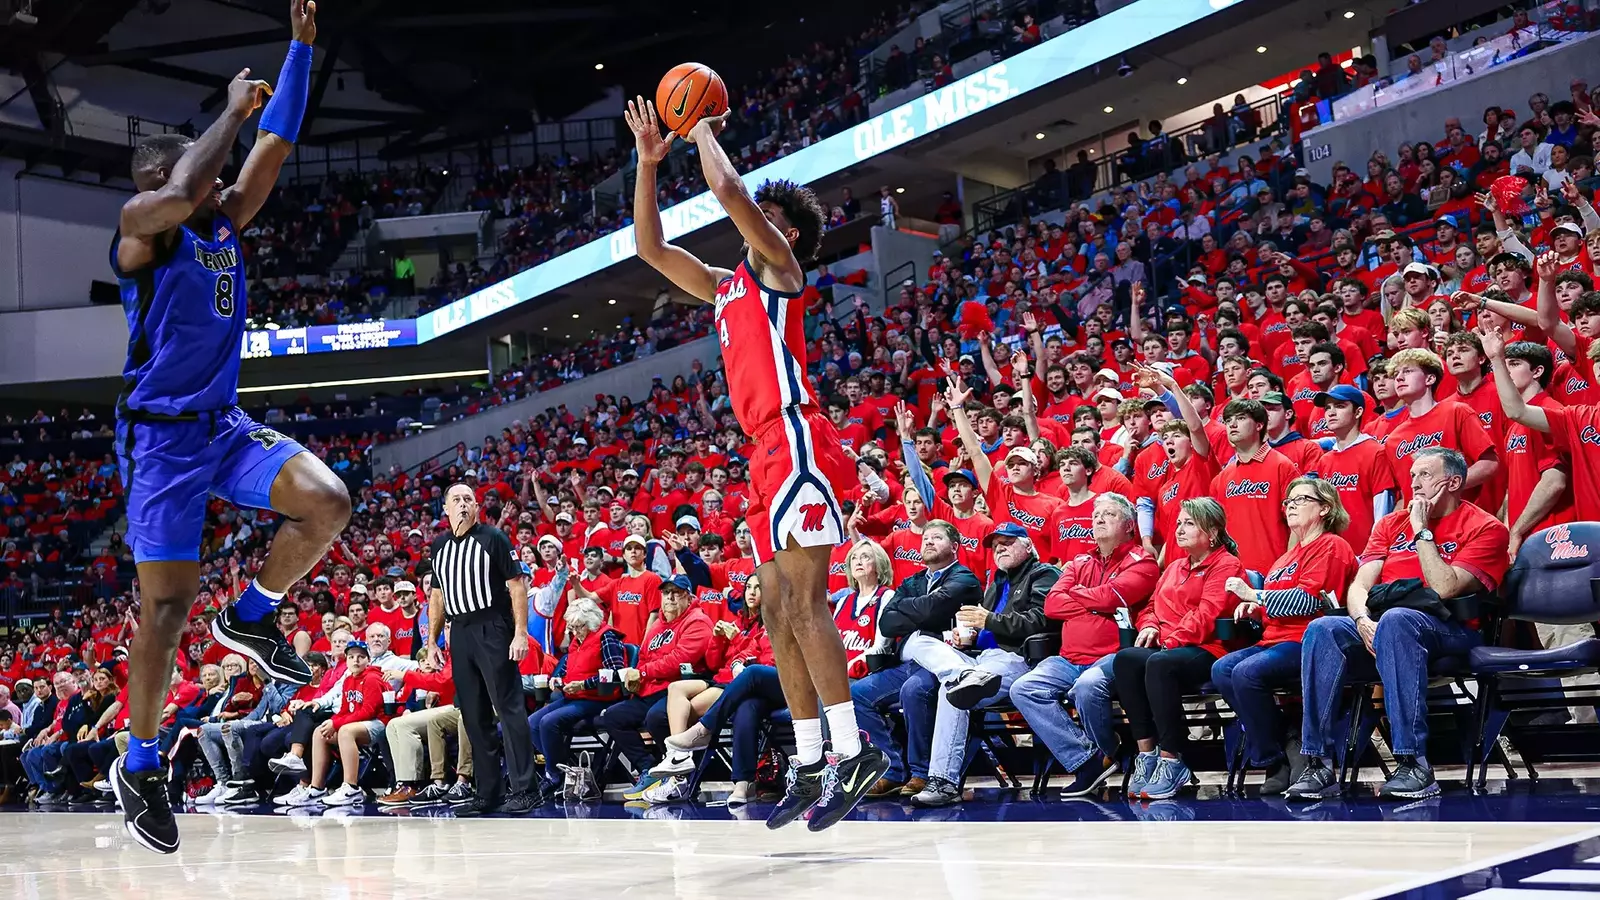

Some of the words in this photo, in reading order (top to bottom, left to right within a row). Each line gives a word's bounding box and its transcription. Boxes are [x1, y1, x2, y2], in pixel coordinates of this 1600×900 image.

[854, 103, 914, 160] OLE
[1311, 145, 1330, 160] 104
[215, 272, 234, 317] 8
[433, 299, 466, 336] OLE
[1226, 479, 1270, 498] Culture
[800, 503, 828, 532] M
[1545, 525, 1571, 544] Ole
[1551, 541, 1588, 560] Miss
[843, 630, 872, 651] Miss
